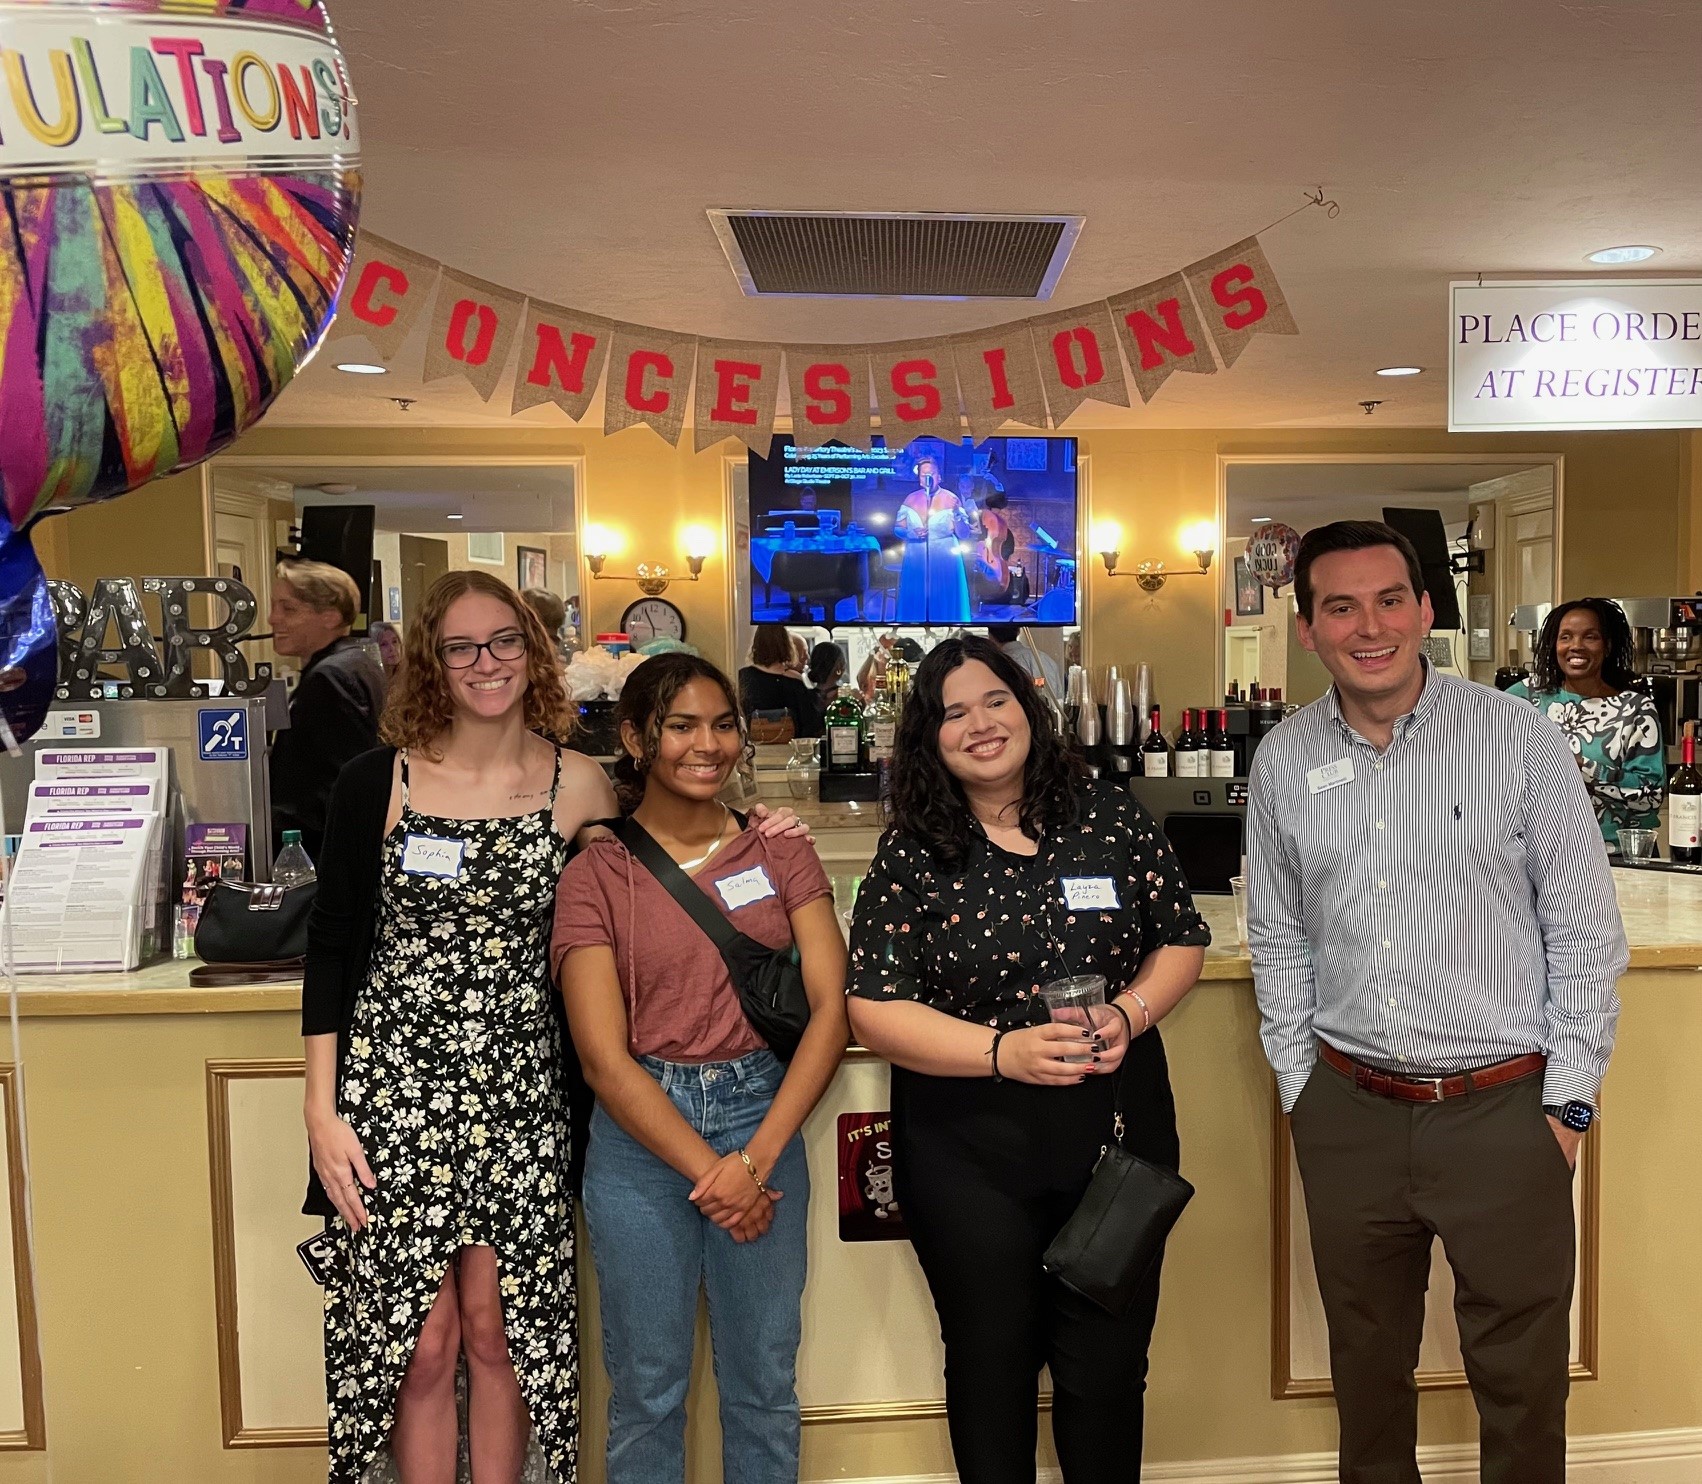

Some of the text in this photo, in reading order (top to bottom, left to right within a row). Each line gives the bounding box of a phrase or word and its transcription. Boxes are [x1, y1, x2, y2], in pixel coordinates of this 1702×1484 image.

[0, 36, 350, 147] ULATIONS!
[1458, 312, 1701, 344] PLACE ORDE
[350, 261, 1268, 426] CONCESSIONS
[1474, 369, 1525, 399] AT
[56, 755, 82, 763] FLORIDA
[412, 845, 451, 861] Sophia
[847, 1119, 892, 1143] IT'S IN
